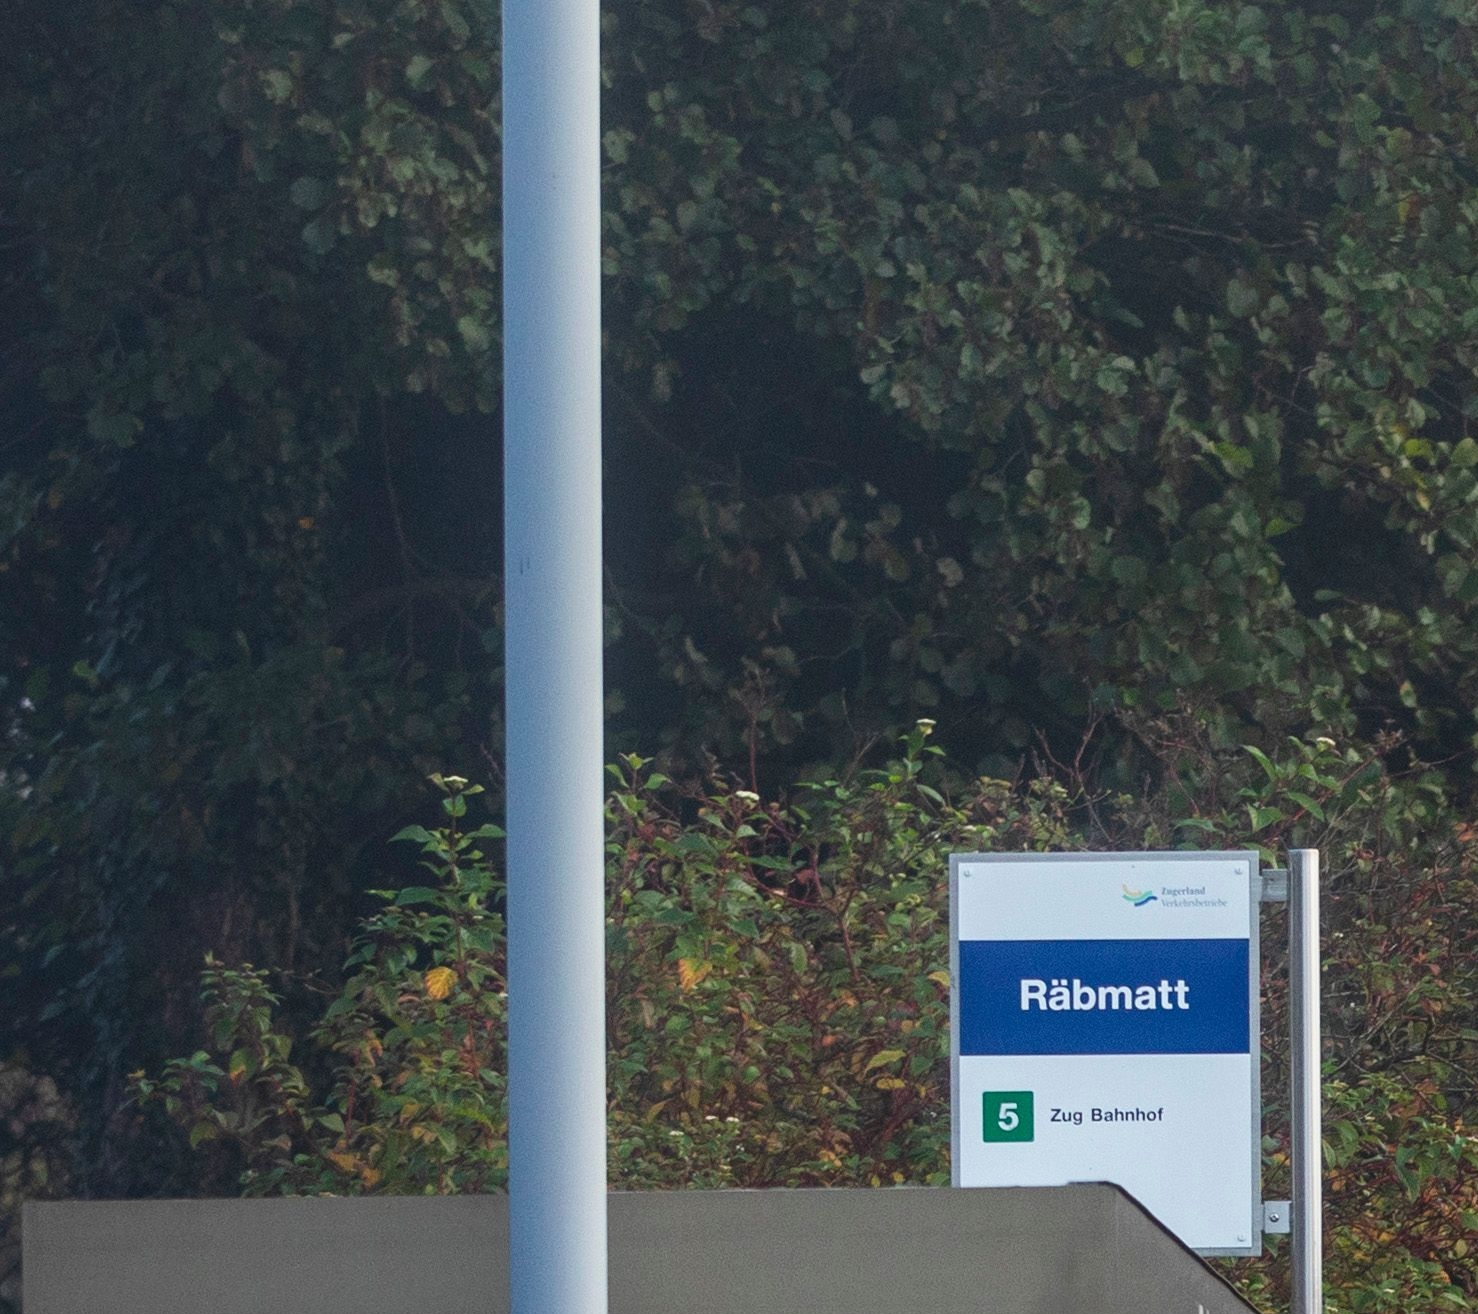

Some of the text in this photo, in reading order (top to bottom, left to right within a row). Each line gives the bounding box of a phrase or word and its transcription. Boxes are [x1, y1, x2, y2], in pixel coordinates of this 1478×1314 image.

[1161, 886, 1206, 897] Zugerland
[1020, 978, 1190, 1011] Räbmatt
[997, 1102, 1164, 1132] 5 Zug Bahnhof
